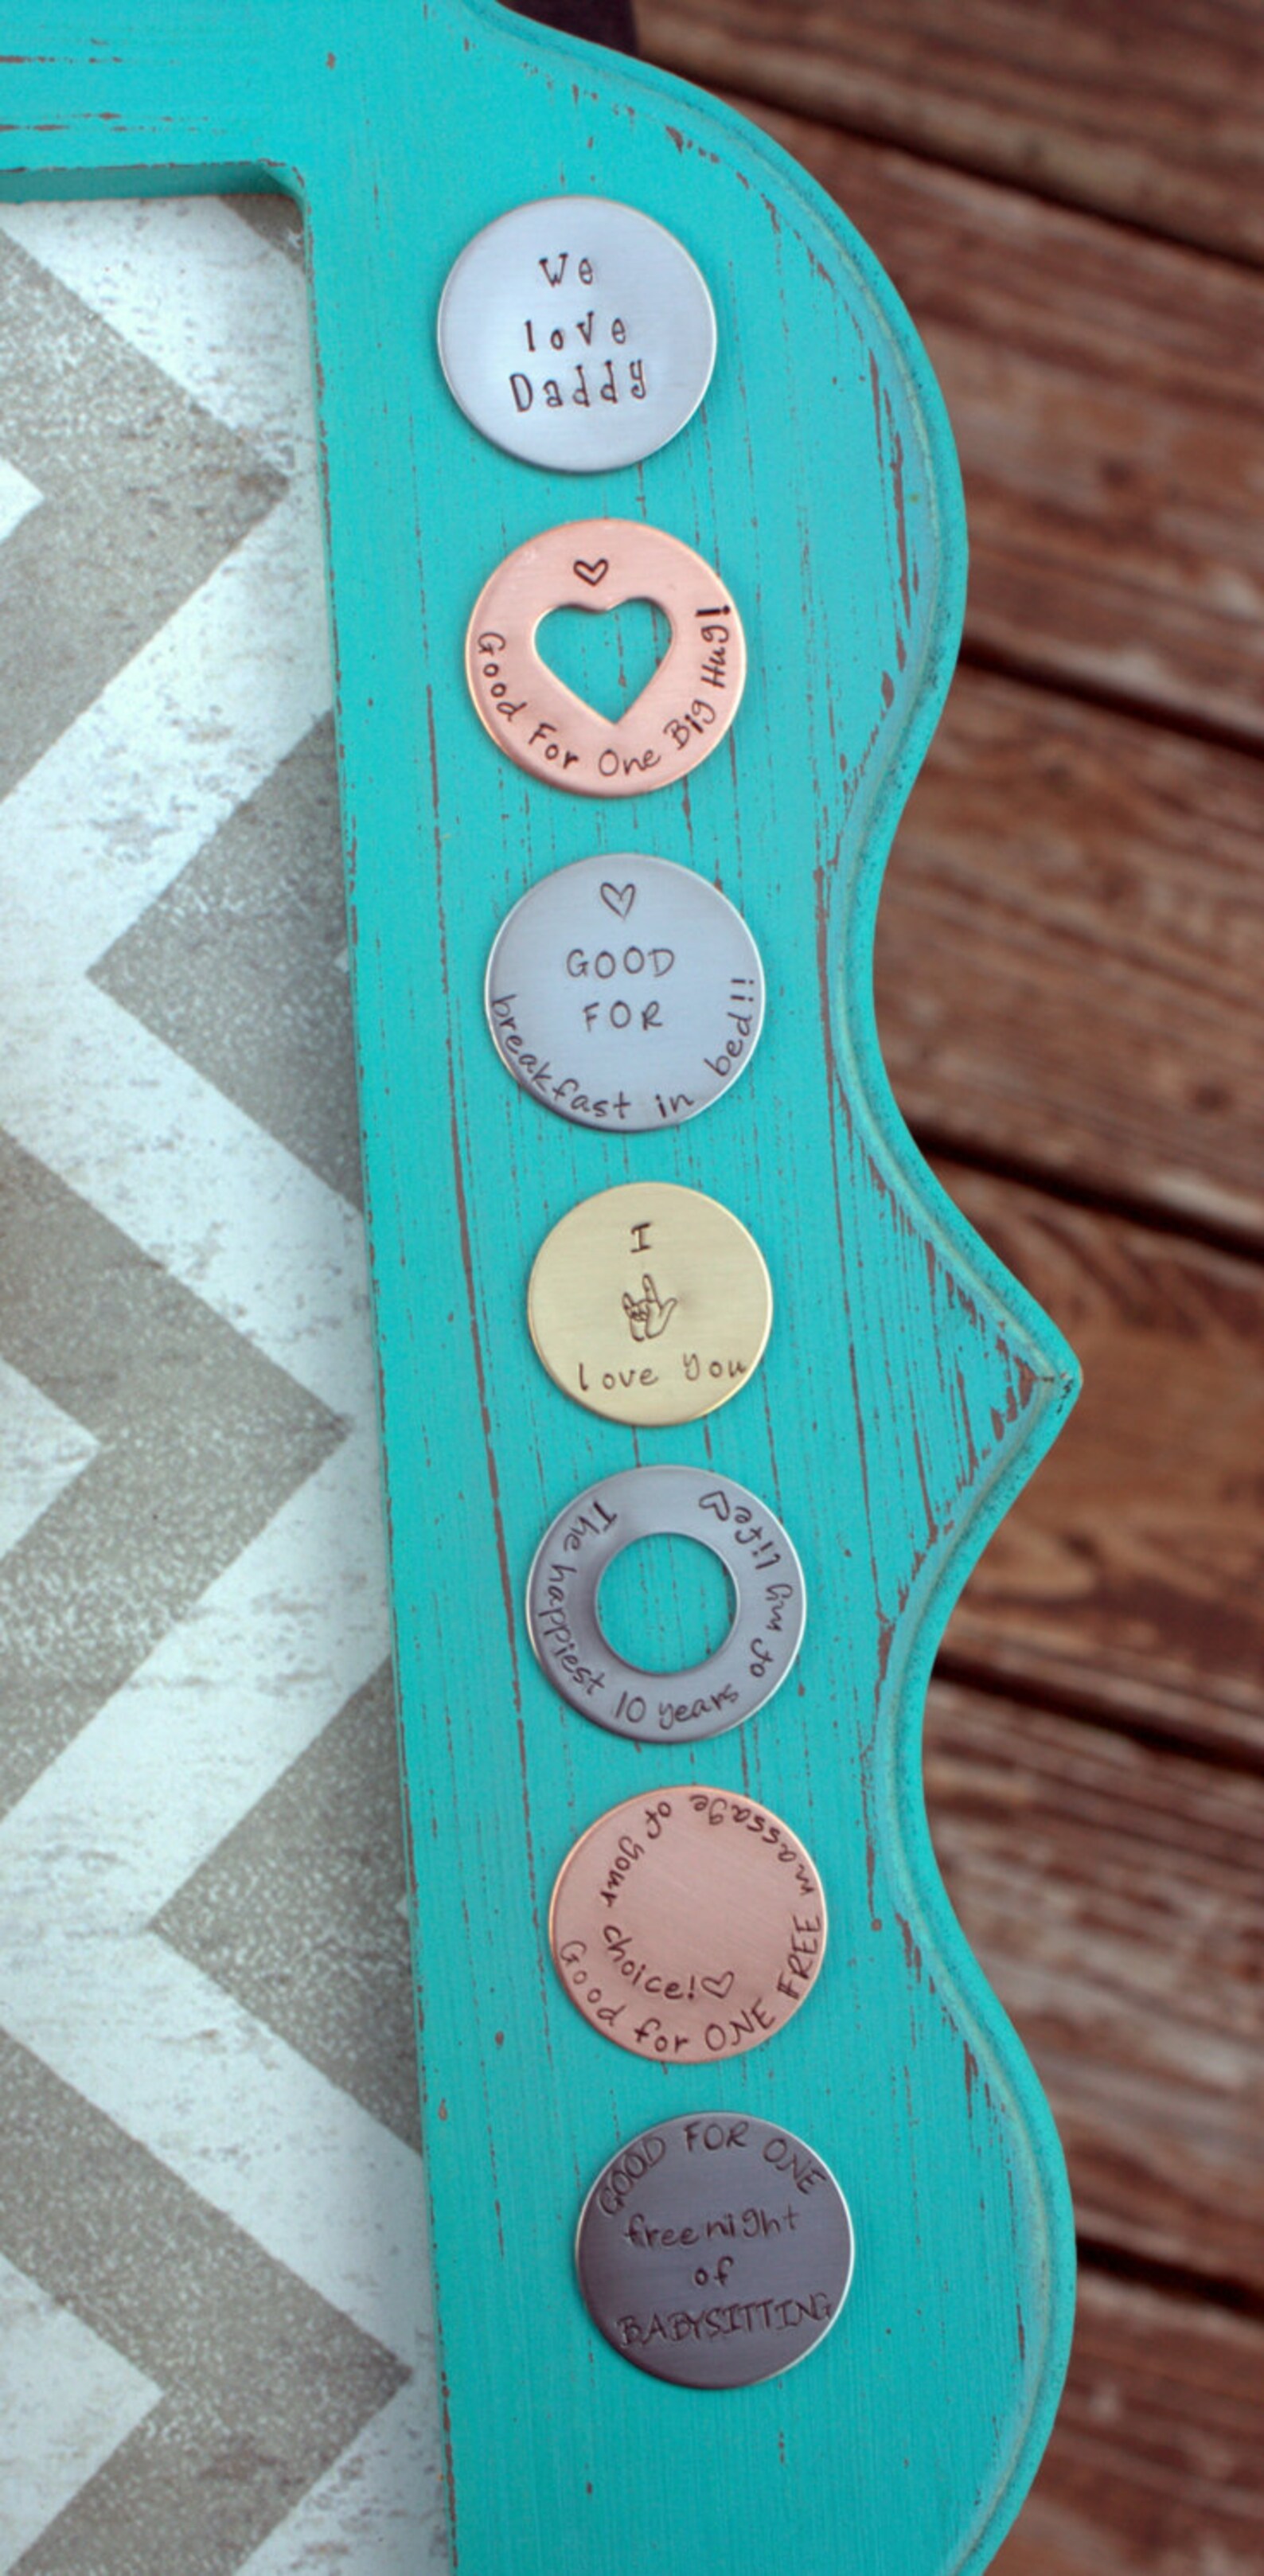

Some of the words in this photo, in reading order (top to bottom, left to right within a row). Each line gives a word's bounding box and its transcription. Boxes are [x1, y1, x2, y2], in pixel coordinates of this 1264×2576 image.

[539, 252, 593, 287] We
[525, 310, 626, 352] love
[509, 359, 646, 412] Daddy
[478, 632, 527, 721] Good
[529, 723, 579, 769] For
[599, 748, 661, 776] One
[663, 700, 716, 751] Big
[695, 605, 730, 689] Hug!
[567, 946, 675, 978] GOOD
[583, 1001, 663, 1032] FOR
[491, 994, 630, 1119] breakfast
[655, 1094, 694, 1118] in
[704, 978, 754, 1077] bed!!
[630, 1222, 652, 1253] I
[579, 1363, 658, 1391] love
[564, 1501, 617, 1551] The
[734, 1506, 781, 1570] life
[538, 1563, 606, 1695] happiest
[766, 1583, 793, 1632] my
[750, 1638, 774, 1677] of
[614, 1691, 646, 1723] 10
[658, 1683, 739, 1730] years
[646, 1802, 672, 1839] of
[689, 1794, 814, 1896] massage
[600, 1836, 645, 1907] your
[603, 1925, 695, 2000] choice!
[776, 1915, 821, 2000] FREE
[559, 1940, 626, 2026] Good
[634, 2018, 689, 2052] for
[704, 1997, 776, 2051] ONE
[599, 2137, 666, 2215] GOOD
[684, 2121, 750, 2152] FOR
[763, 2137, 827, 2195] ONE
[625, 2214, 700, 2247] free
[706, 2204, 800, 2238] night
[694, 2256, 734, 2286] of
[617, 2292, 833, 2346] BABYSITTING
